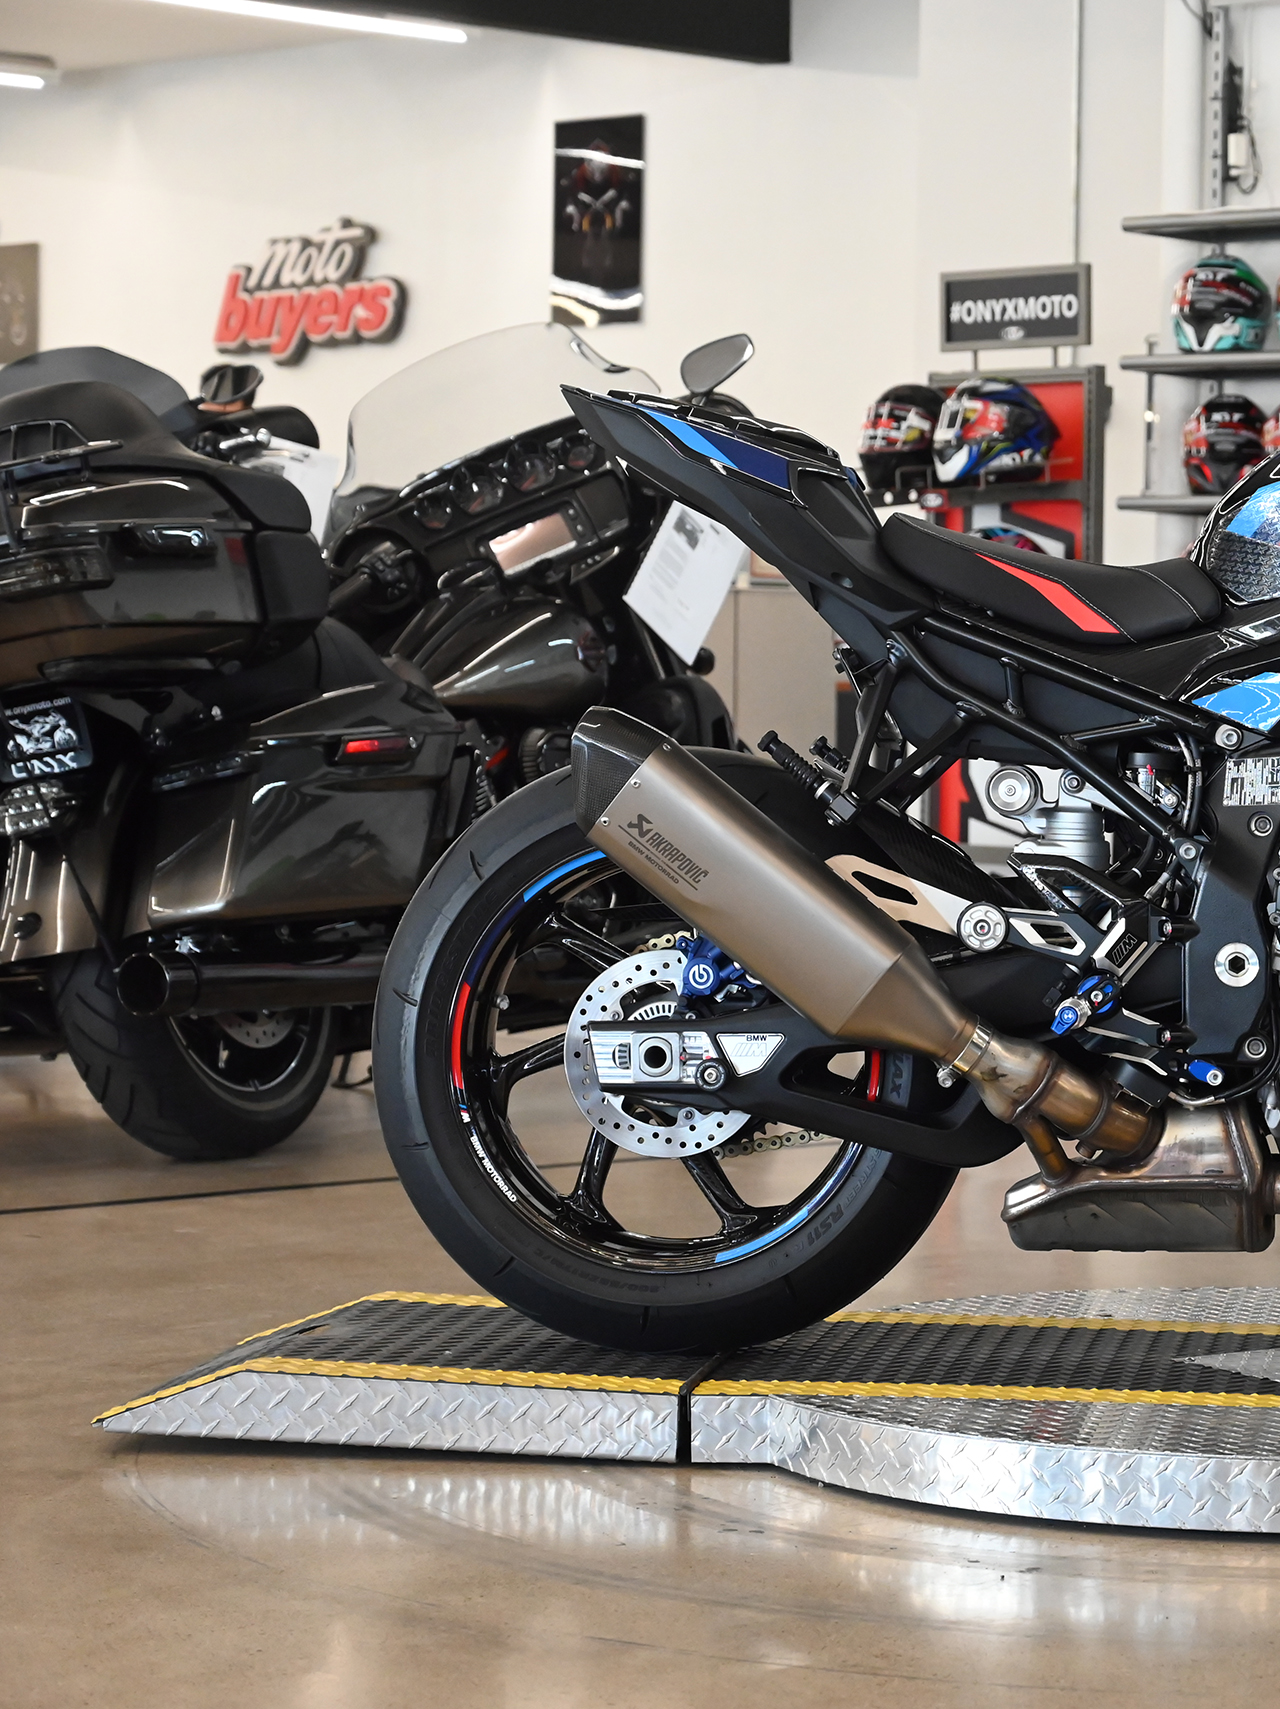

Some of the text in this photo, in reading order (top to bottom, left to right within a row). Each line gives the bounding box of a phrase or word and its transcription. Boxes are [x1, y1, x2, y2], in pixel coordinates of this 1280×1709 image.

[213, 270, 396, 357] buyers
[950, 294, 1079, 324] #ONYXMOTO
[628, 841, 680, 884] BMW MOTORRAD
[645, 831, 709, 884] AKRAPOVIČ
[746, 1034, 768, 1042] BMW
[469, 1135, 518, 1203] BMW MOTORRAD
